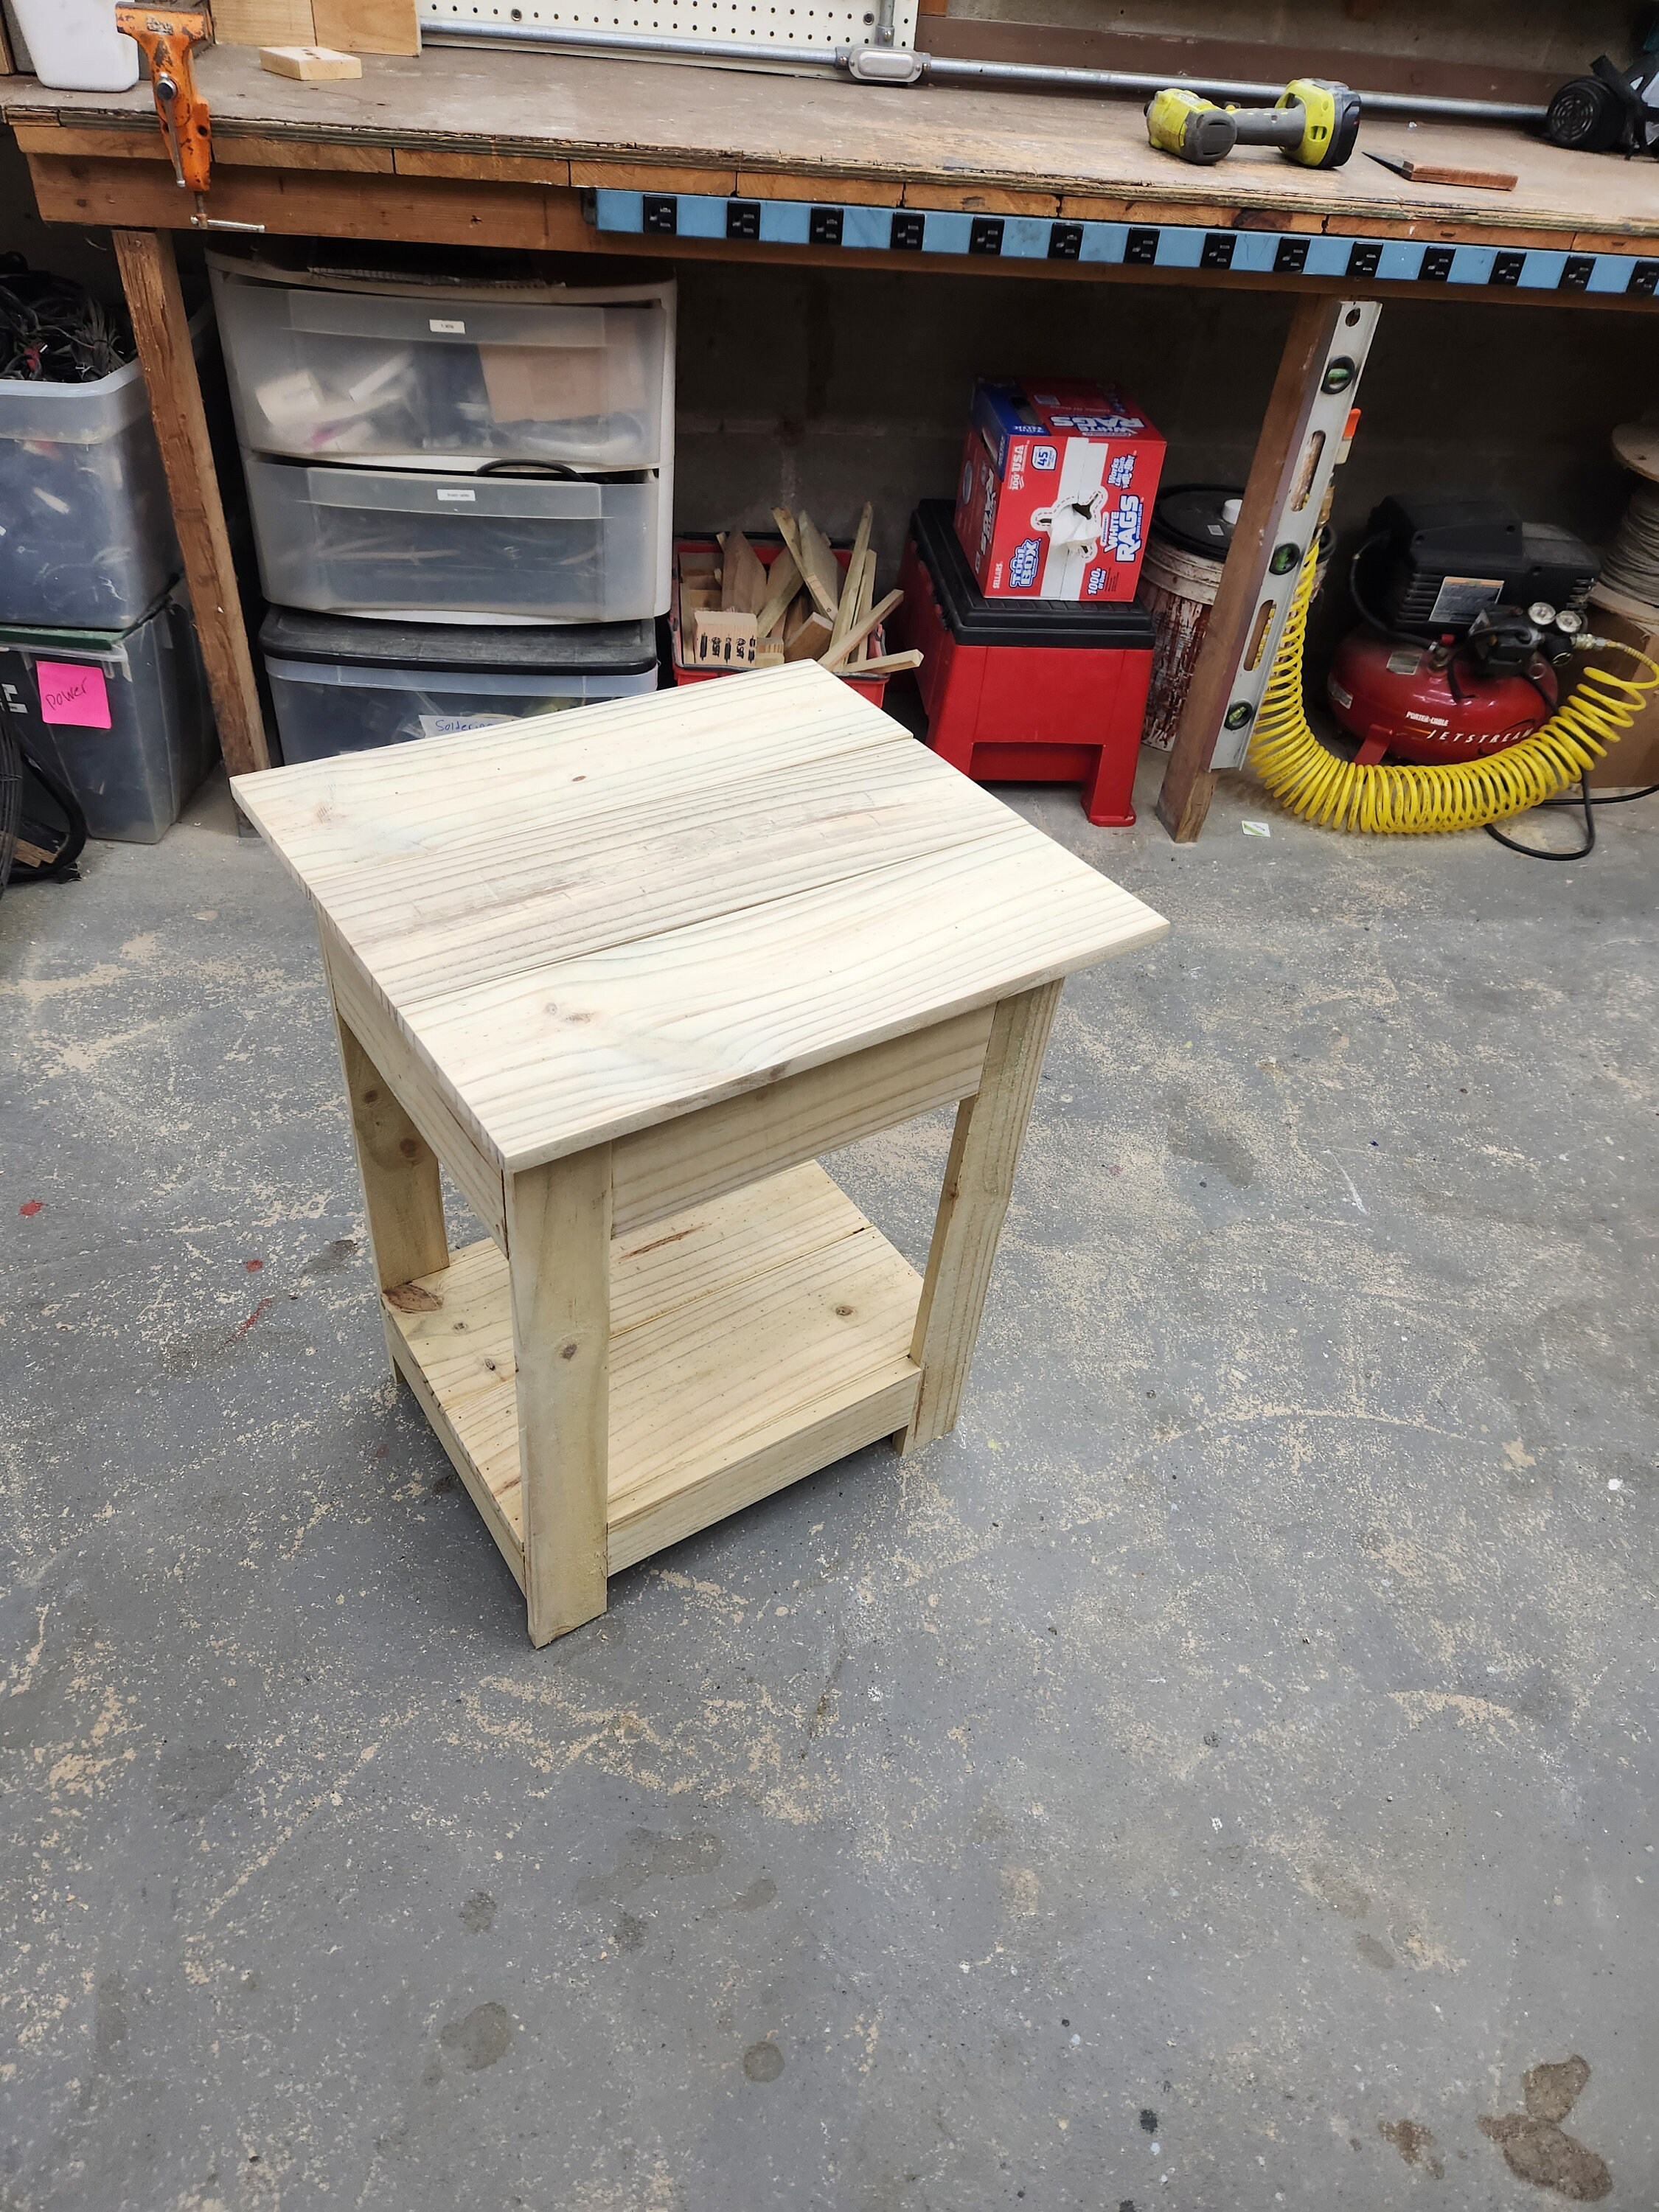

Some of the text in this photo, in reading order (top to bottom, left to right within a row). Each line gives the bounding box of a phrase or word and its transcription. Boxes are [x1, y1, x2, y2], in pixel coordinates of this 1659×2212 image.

[1051, 414, 1144, 428] RAGS
[1012, 445, 1024, 472] USA
[1108, 458, 1119, 484] Works
[1104, 512, 1119, 552] WHITE
[1116, 495, 1141, 561] RAGS
[1020, 540, 1038, 585] BOX
[992, 563, 1003, 589] SELLARS
[435, 719, 493, 731] Solderin
[1427, 727, 1534, 743] JETSTREAM
